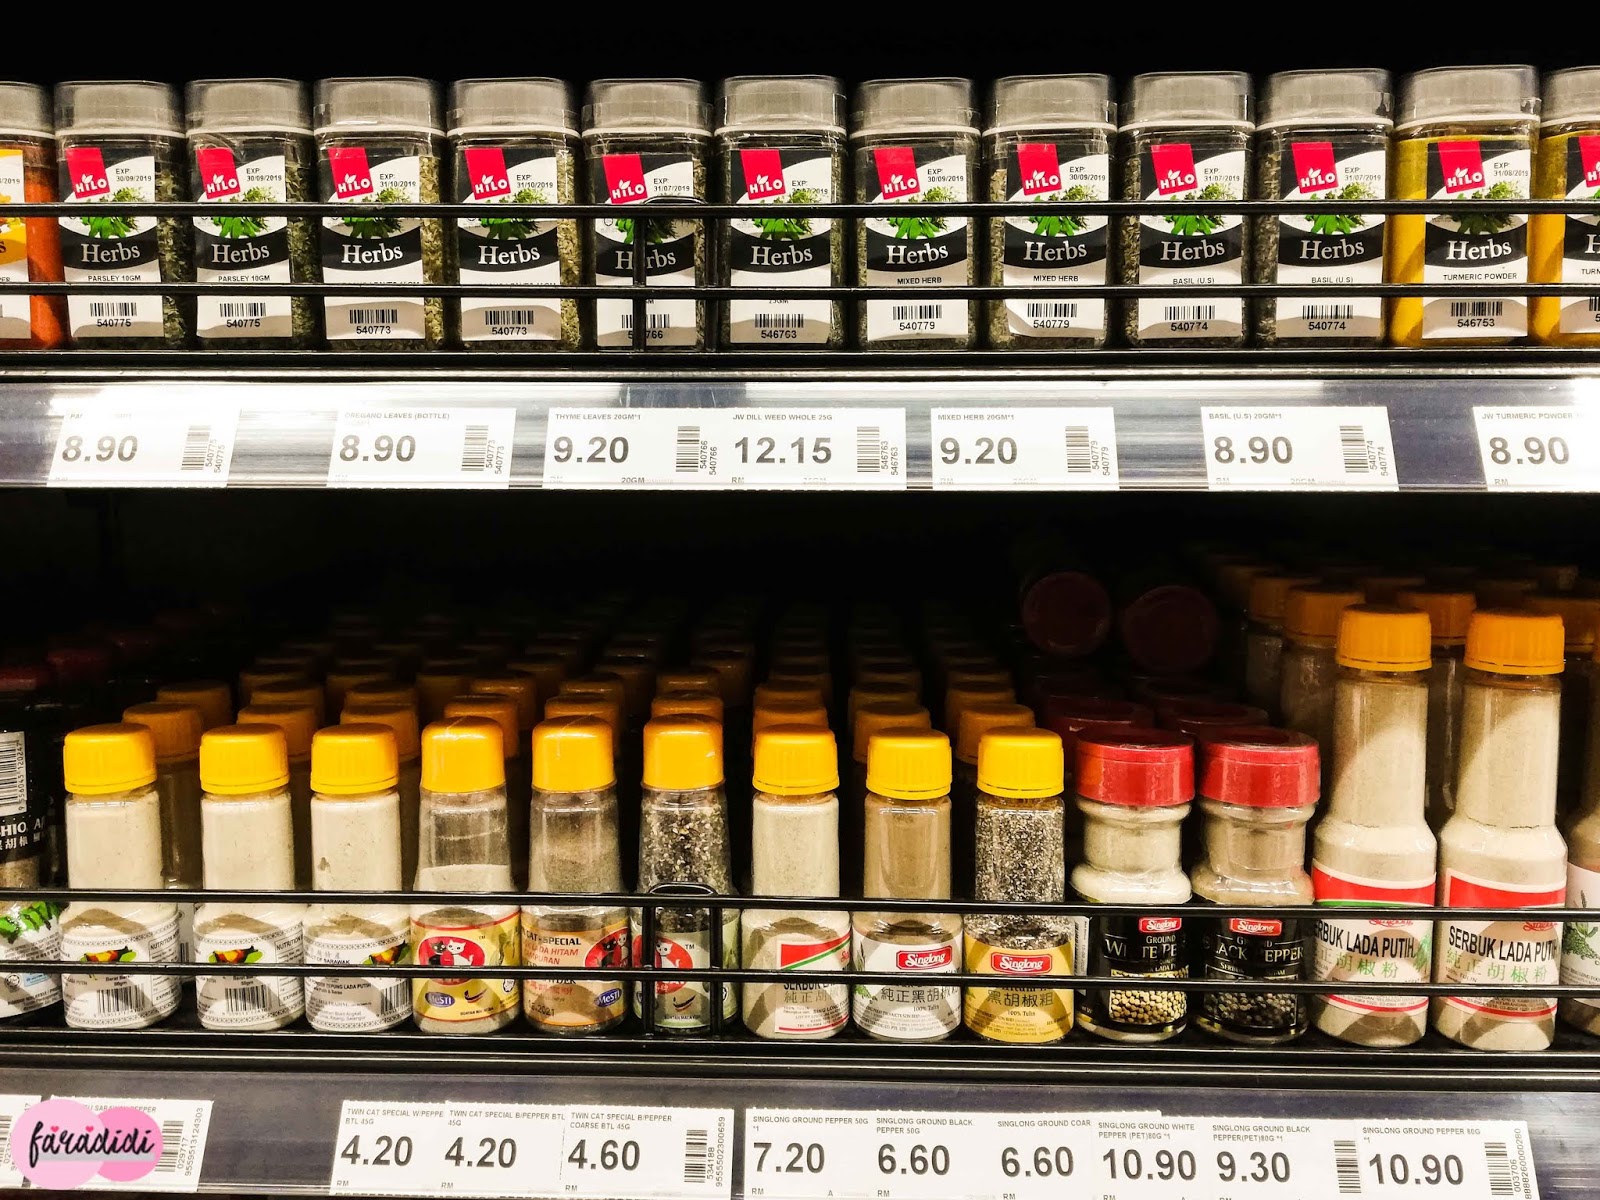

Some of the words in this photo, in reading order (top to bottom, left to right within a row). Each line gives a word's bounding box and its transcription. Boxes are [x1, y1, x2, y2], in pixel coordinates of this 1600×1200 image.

[81, 242, 140, 263] Herbs
[211, 243, 270, 264] Herbs
[341, 243, 403, 264] Herbs
[478, 244, 540, 265] Herbs
[615, 249, 677, 270] Hrbs
[750, 244, 813, 266] Herbs
[886, 243, 949, 265] Herbs
[1023, 240, 1087, 262] Herbs
[1160, 239, 1225, 262] Herbs
[1299, 239, 1364, 260] Herbs
[1446, 238, 1512, 261] Herbs
[897, 277, 920, 285] MIXED
[1443, 273, 1482, 281] TURMERIC
[1484, 272, 1517, 280] POWDER
[97, 318, 132, 328] 540775
[226, 318, 261, 328] 540775
[356, 325, 392, 335] 540773
[491, 326, 527, 336] 540773
[899, 321, 935, 330] 540779
[1033, 320, 1070, 329] 540779
[1171, 322, 1208, 331] 540774
[1308, 321, 1346, 330] 540774
[1457, 318, 1495, 327] 546753
[761, 330, 797, 339] 546763
[414, 412, 450, 420] (BOTTLE)
[62, 435, 138, 463] 8.90
[339, 435, 416, 462] 8.90
[486, 440, 496, 468] 540773
[494, 446, 505, 474] 540773
[554, 436, 629, 464] 9.20
[700, 440, 708, 469] 540766
[735, 436, 832, 464] 12.15
[881, 440, 889, 469] 546763
[940, 437, 1017, 465] 9.20
[1091, 441, 1100, 470] 540779
[1214, 436, 1293, 464] 8.90
[1367, 440, 1378, 470] 540774
[1490, 437, 1569, 464] 8.90
[709, 446, 718, 475] 540766
[891, 447, 899, 475] 546763
[1101, 447, 1110, 475] 540779
[1378, 446, 1389, 476] 540774
[1238, 920, 1274, 932] Singlong
[543, 936, 581, 945] SPECIAL
[1146, 935, 1176, 944] GROUND
[1347, 931, 1379, 957] LADA
[1382, 937, 1415, 958] PUTIH
[1449, 926, 1496, 959] SERBUK
[1499, 940, 1531, 962] LADA
[551, 948, 578, 956] HITAM
[905, 951, 946, 967] Singlong
[1000, 955, 1044, 970] Singlong
[876, 1117, 914, 1125] SINGLONG
[1070, 1119, 1091, 1127] COAR
[1098, 1122, 1136, 1130] SINGLONG
[1172, 1123, 1195, 1131] WHITE
[1252, 1125, 1284, 1133] GROUND
[1402, 1127, 1435, 1135] GROUND
[177, 1137, 187, 1169] 029717
[185, 1107, 203, 1176] 9559513124303
[341, 1135, 413, 1166] 4.20
[445, 1136, 517, 1168] 4.20
[716, 1116, 726, 1187] 9555502300659
[568, 1139, 640, 1171] 4.60
[707, 1147, 715, 1179] 534188
[753, 1142, 825, 1173] 7.20
[877, 1143, 950, 1176] 6.60
[1001, 1146, 1074, 1178] 6.60
[1102, 1149, 1197, 1181] 10.90
[1217, 1151, 1290, 1183] 9.30
[1369, 1153, 1464, 1186] 10.90
[1510, 1159, 1522, 1193] 003706
